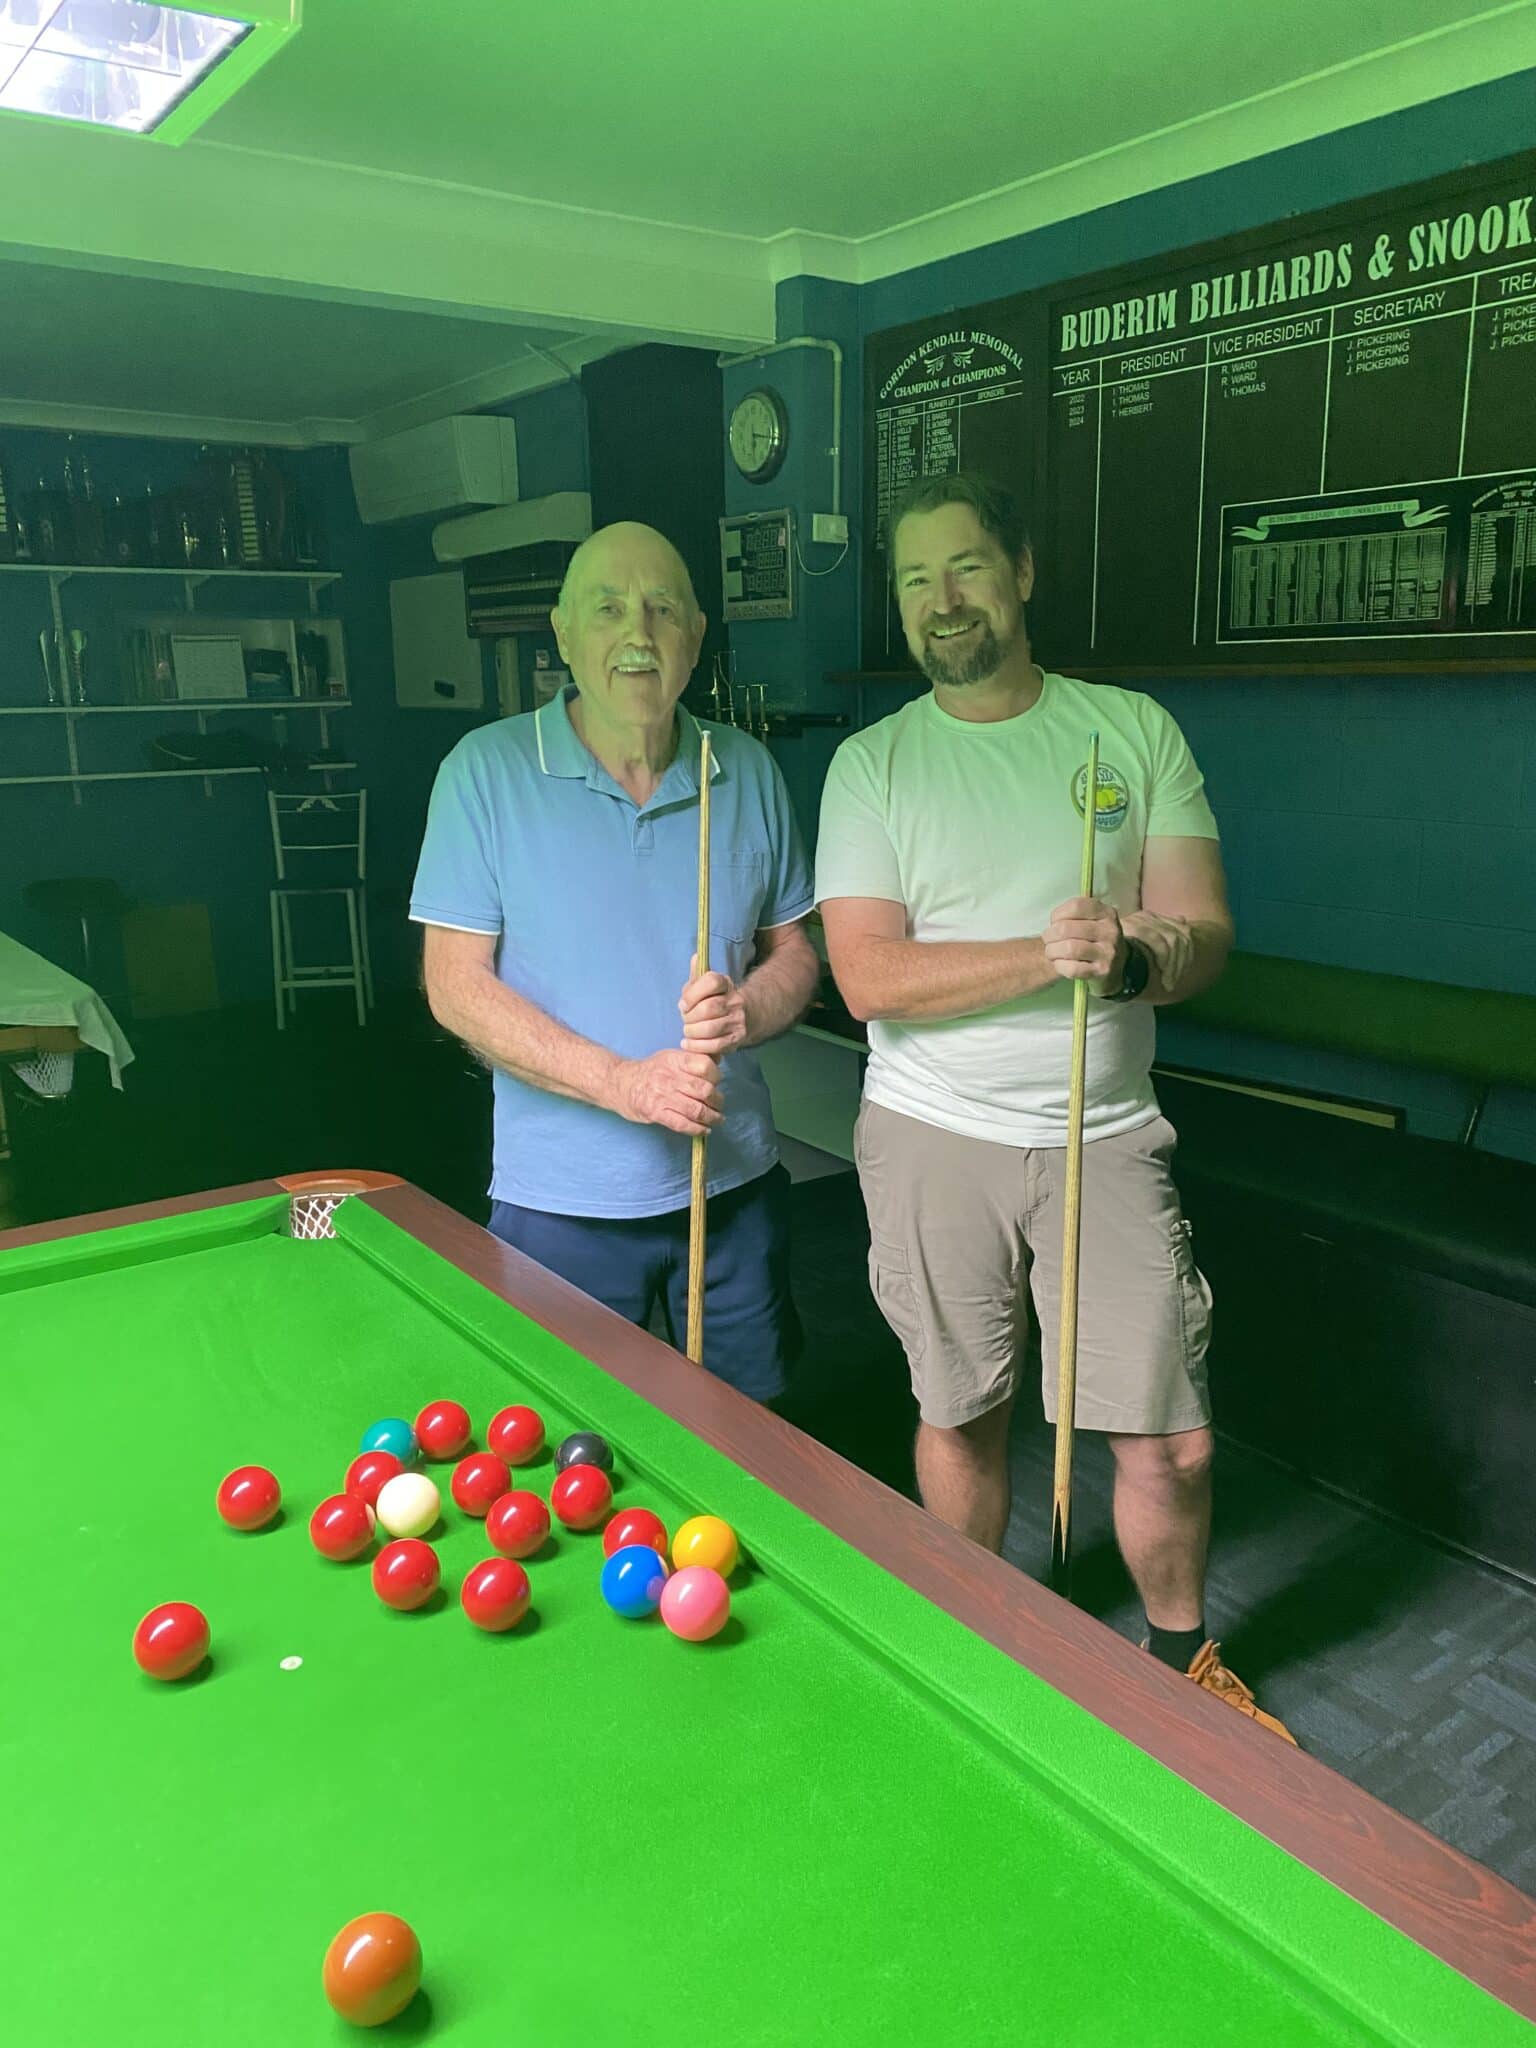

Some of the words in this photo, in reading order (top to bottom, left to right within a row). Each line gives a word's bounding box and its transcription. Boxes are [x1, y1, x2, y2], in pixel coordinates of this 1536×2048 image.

[1061, 288, 1178, 352] BUDERIM
[1190, 242, 1354, 324] BILLIARDS
[1367, 233, 1396, 280] &
[1408, 196, 1536, 272] SNOOK
[1353, 290, 1446, 326] SECRETARY
[1213, 336, 1243, 356] VICE
[1246, 318, 1323, 349] PRESIDENT
[1357, 328, 1411, 349] PICKERING
[1356, 341, 1410, 361] PICKERING
[880, 351, 917, 399] GORDON
[918, 331, 967, 358] KENDALL
[970, 331, 1024, 371] MEMORIAL
[1120, 348, 1187, 375] PRESIDENT
[1232, 360, 1257, 373] WARD
[1355, 354, 1409, 374] PICKERING
[894, 379, 939, 398] CHAMPION
[952, 364, 1007, 386] CHAMPIONS
[1061, 368, 1090, 386] YEAR
[1231, 371, 1257, 384] WARD
[1119, 380, 1150, 395] THOMAS
[1230, 382, 1266, 397] THOMAS
[1119, 392, 1150, 405] THOMAS
[1118, 403, 1154, 417] HERBERT
